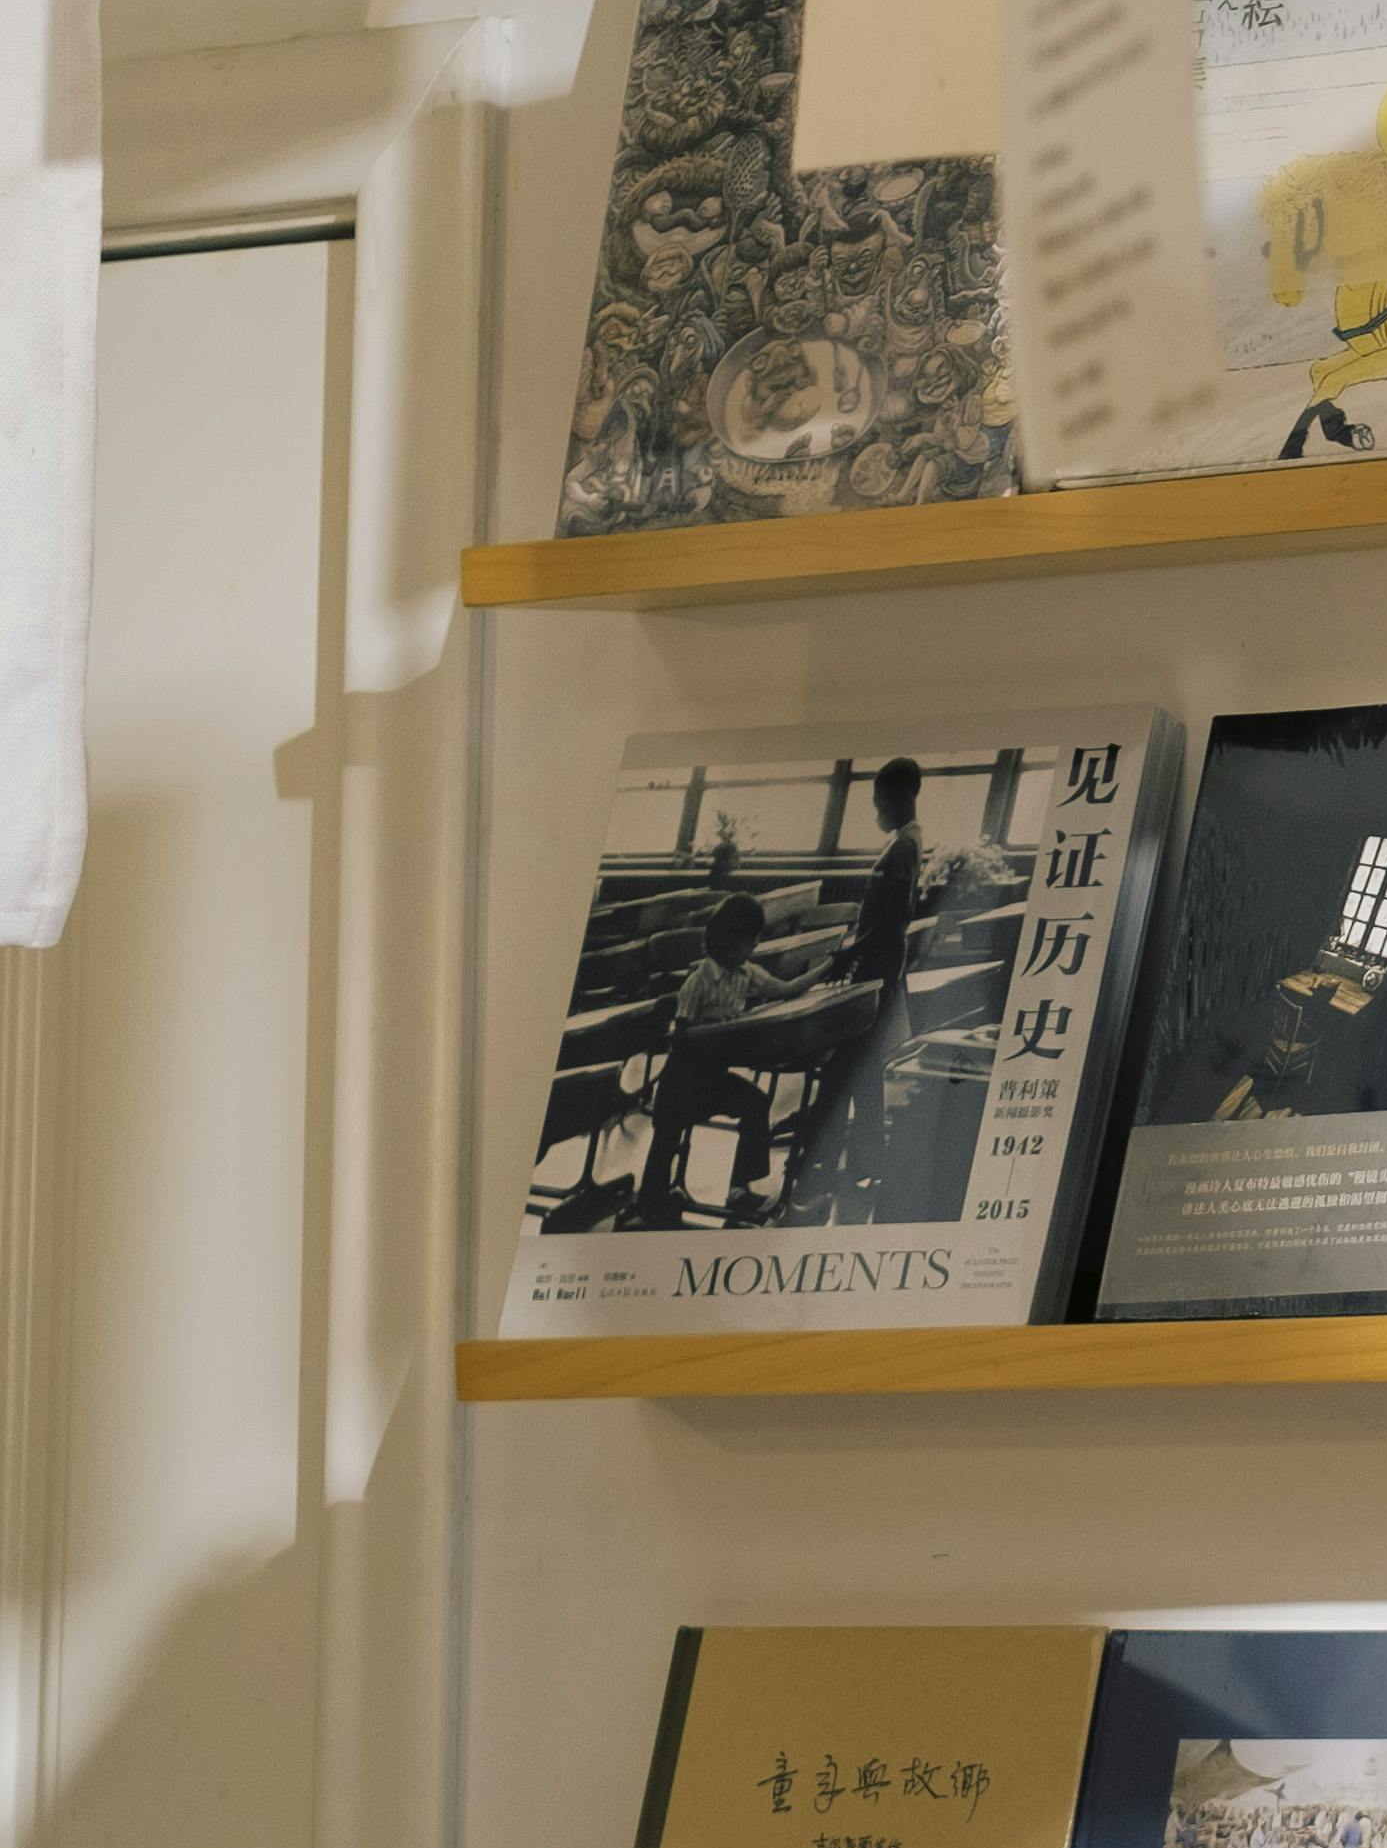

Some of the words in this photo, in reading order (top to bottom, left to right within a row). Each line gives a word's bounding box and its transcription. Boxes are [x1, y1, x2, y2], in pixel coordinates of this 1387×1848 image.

[1003, 742, 1123, 1062] 见证历史
[998, 1078, 1060, 1101] 普利策
[990, 1134, 1044, 1157] 1942
[975, 1199, 1030, 1220] 2015
[672, 1248, 953, 1298] MOMENTS
